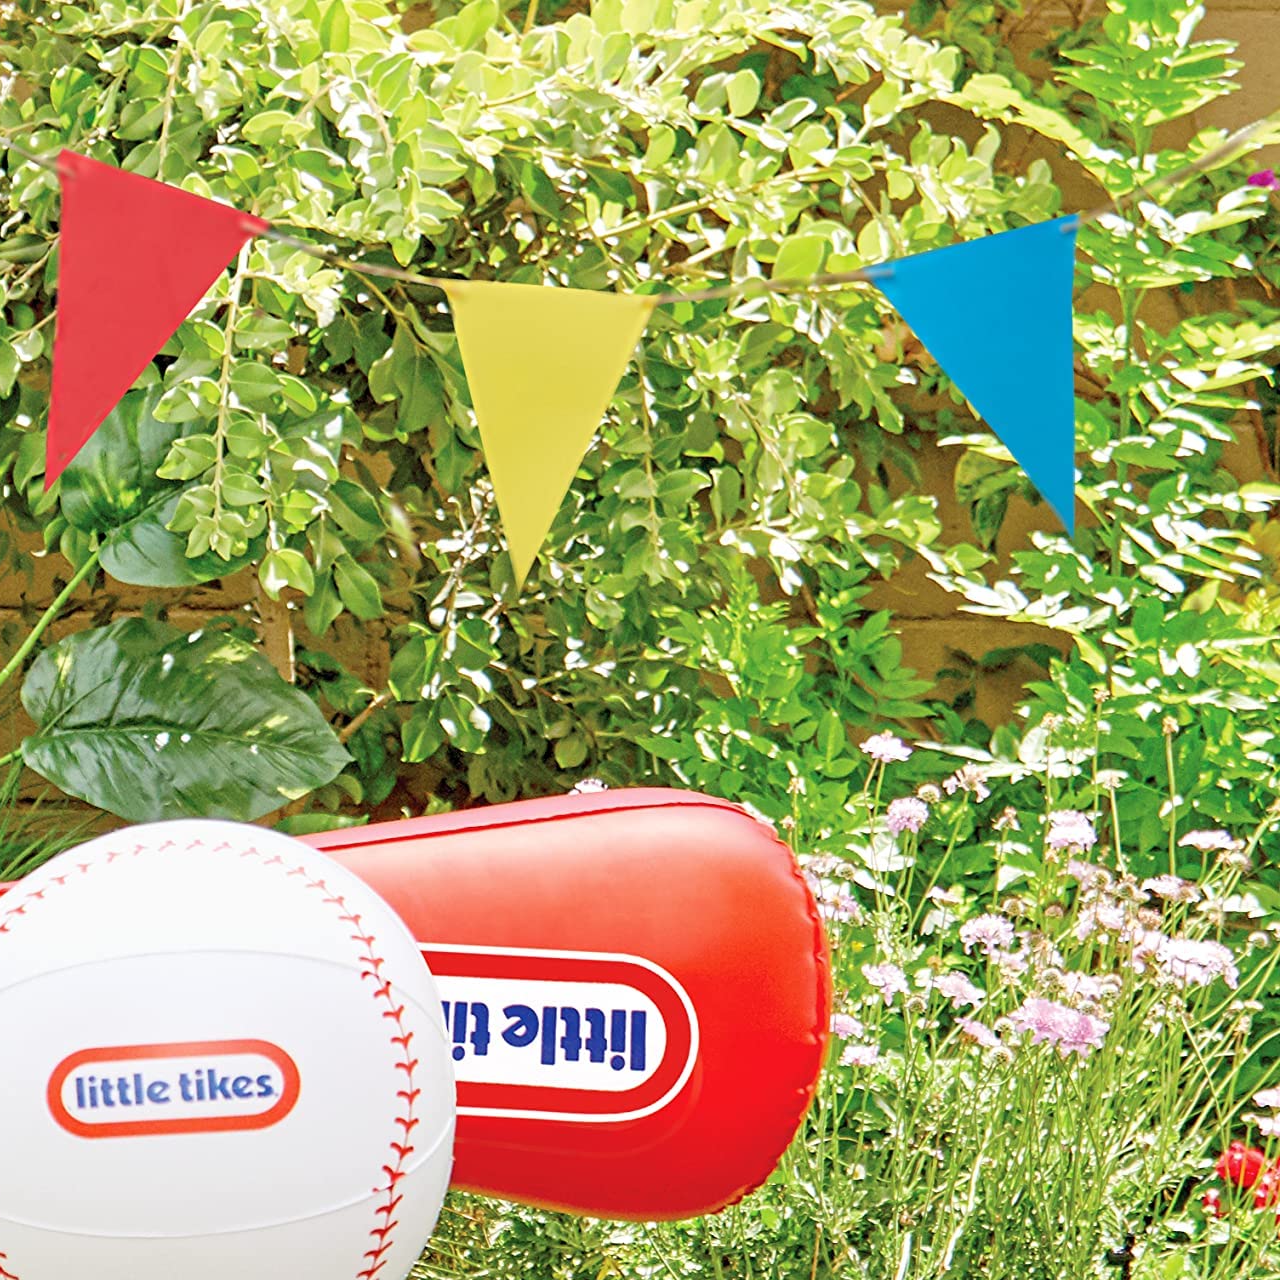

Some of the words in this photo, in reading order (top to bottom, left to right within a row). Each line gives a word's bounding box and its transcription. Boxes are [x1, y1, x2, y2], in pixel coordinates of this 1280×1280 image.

[501, 1004, 647, 1071] little
[75, 1073, 171, 1109] little
[179, 1068, 274, 1103] tikes
